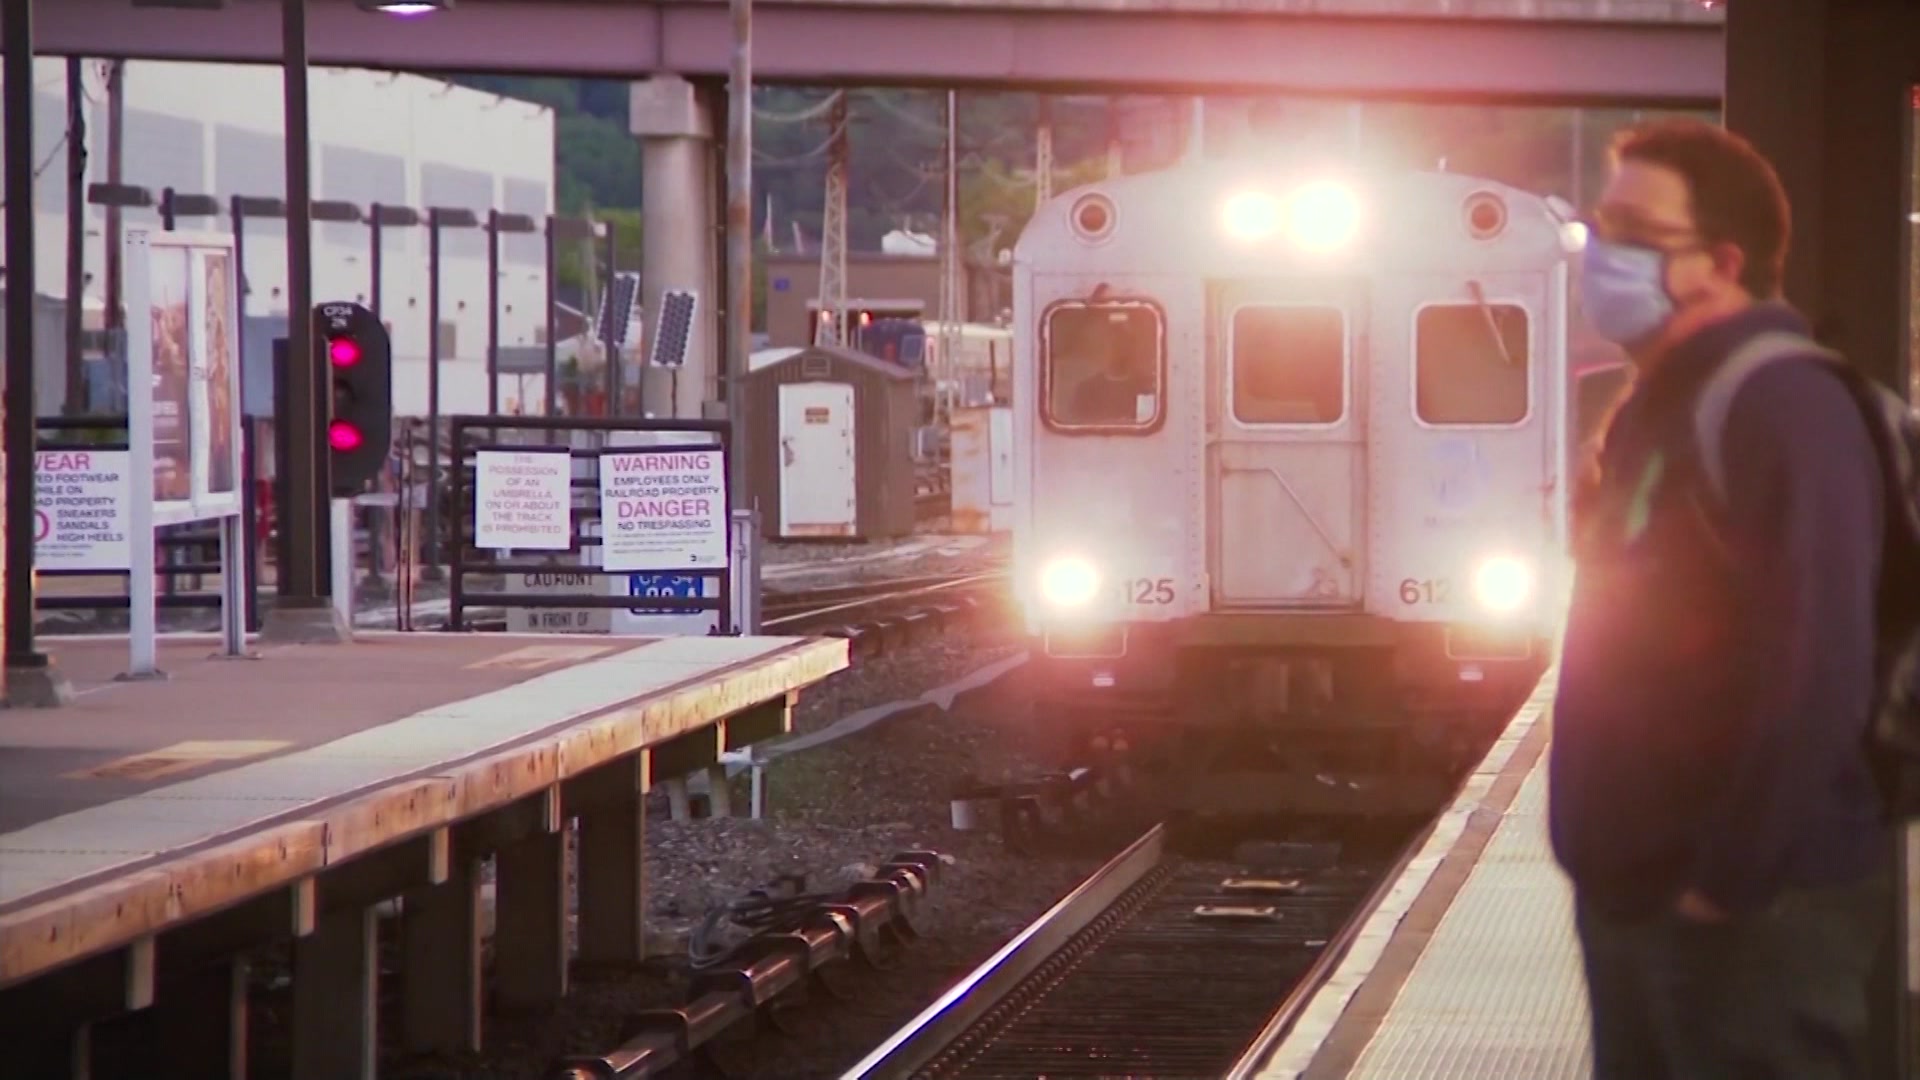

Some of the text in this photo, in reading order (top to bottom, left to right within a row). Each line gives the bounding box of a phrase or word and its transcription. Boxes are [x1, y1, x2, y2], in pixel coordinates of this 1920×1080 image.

[613, 454, 710, 471] WARNING
[488, 465, 558, 475] POSSESSION
[56, 473, 119, 483] FOOTWEAR
[614, 475, 710, 486] EMPLOYEES ONLY
[35, 486, 83, 494] HILE ON
[493, 490, 552, 498] UMBRELLA
[605, 486, 720, 498] RAILROAD PROPERTY
[56, 497, 116, 506] PROPERTY
[485, 501, 560, 509] ON OR ABOUT
[618, 499, 710, 518] DANGER
[57, 510, 116, 518] SNEAKERS
[493, 512, 552, 521] THE TRACK
[57, 521, 109, 530] SANDALS
[495, 524, 561, 533] PROHIBITED
[618, 520, 711, 530] NO TRESPASSING
[57, 533, 124, 541] HIGH HEELS
[543, 612, 572, 626] FRONT
[577, 612, 588, 626] OF
